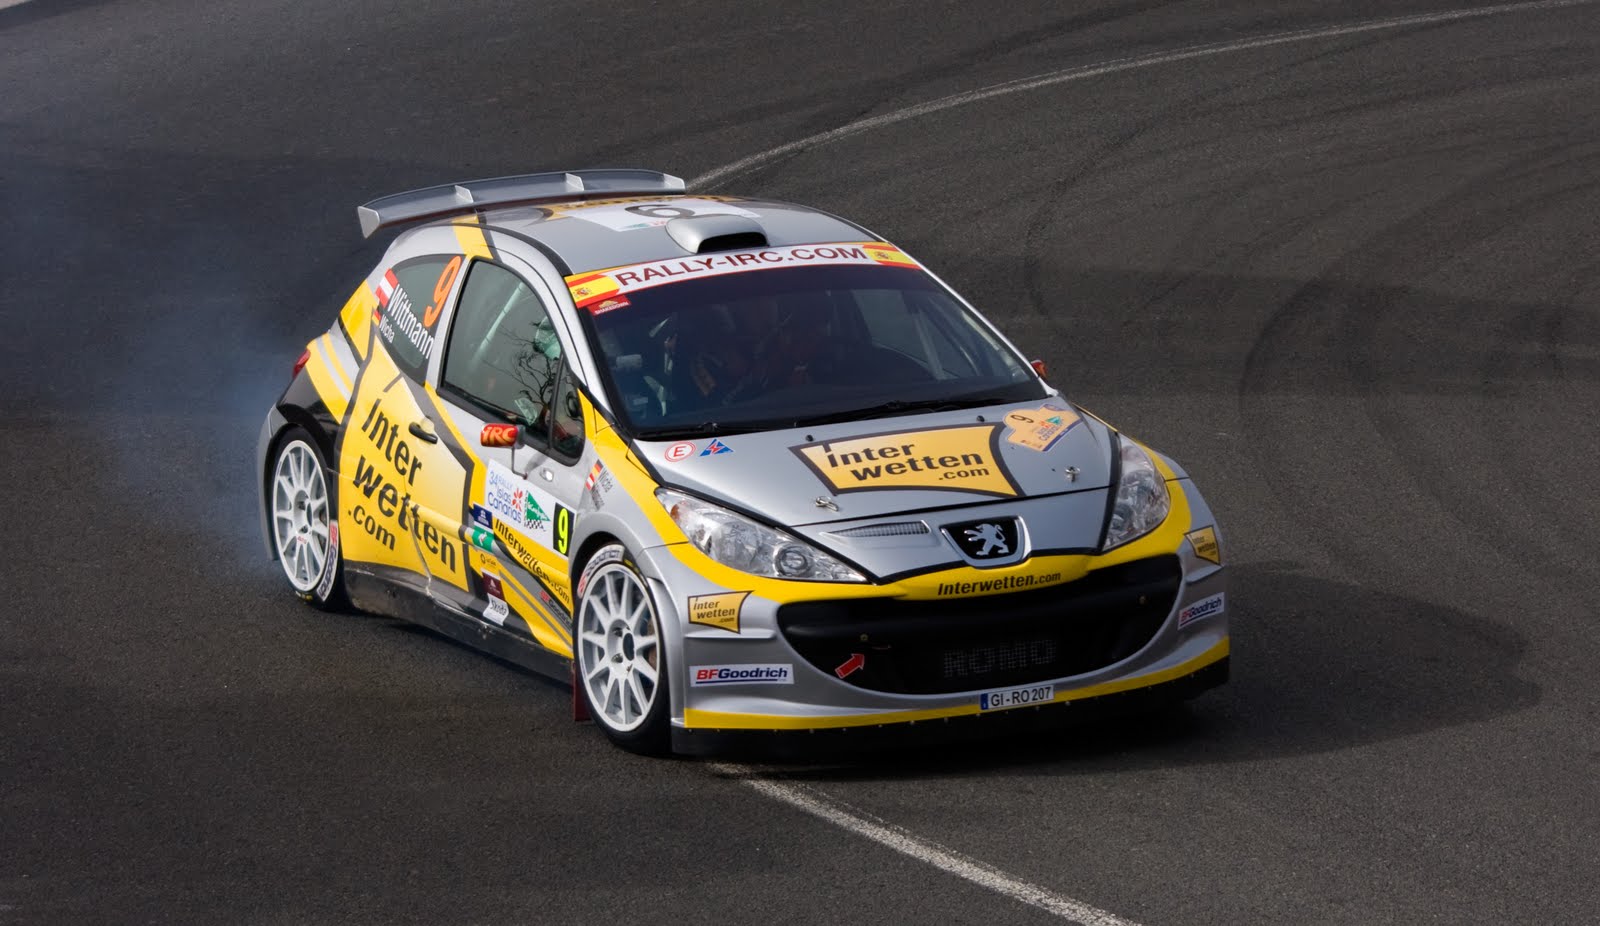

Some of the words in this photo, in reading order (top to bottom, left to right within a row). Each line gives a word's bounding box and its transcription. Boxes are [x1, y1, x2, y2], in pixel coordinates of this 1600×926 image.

[615, 247, 868, 287] RALLY-IRC.COM
[424, 255, 462, 328] 9
[387, 283, 434, 359] Wittmann
[594, 301, 629, 315] SHAKEDOWN
[850, 452, 985, 481] wetten
[938, 467, 990, 481] .com
[348, 504, 397, 551] .com
[352, 454, 456, 574] wetten
[558, 508, 569, 555] 9
[494, 518, 571, 604] Interwetten.com
[937, 572, 1062, 596] Interwetten.com
[696, 608, 736, 620] wetten
[1181, 596, 1222, 622] BFGoodrich
[696, 667, 788, 681] BFGoodrich
[1032, 686, 1052, 701] 207
